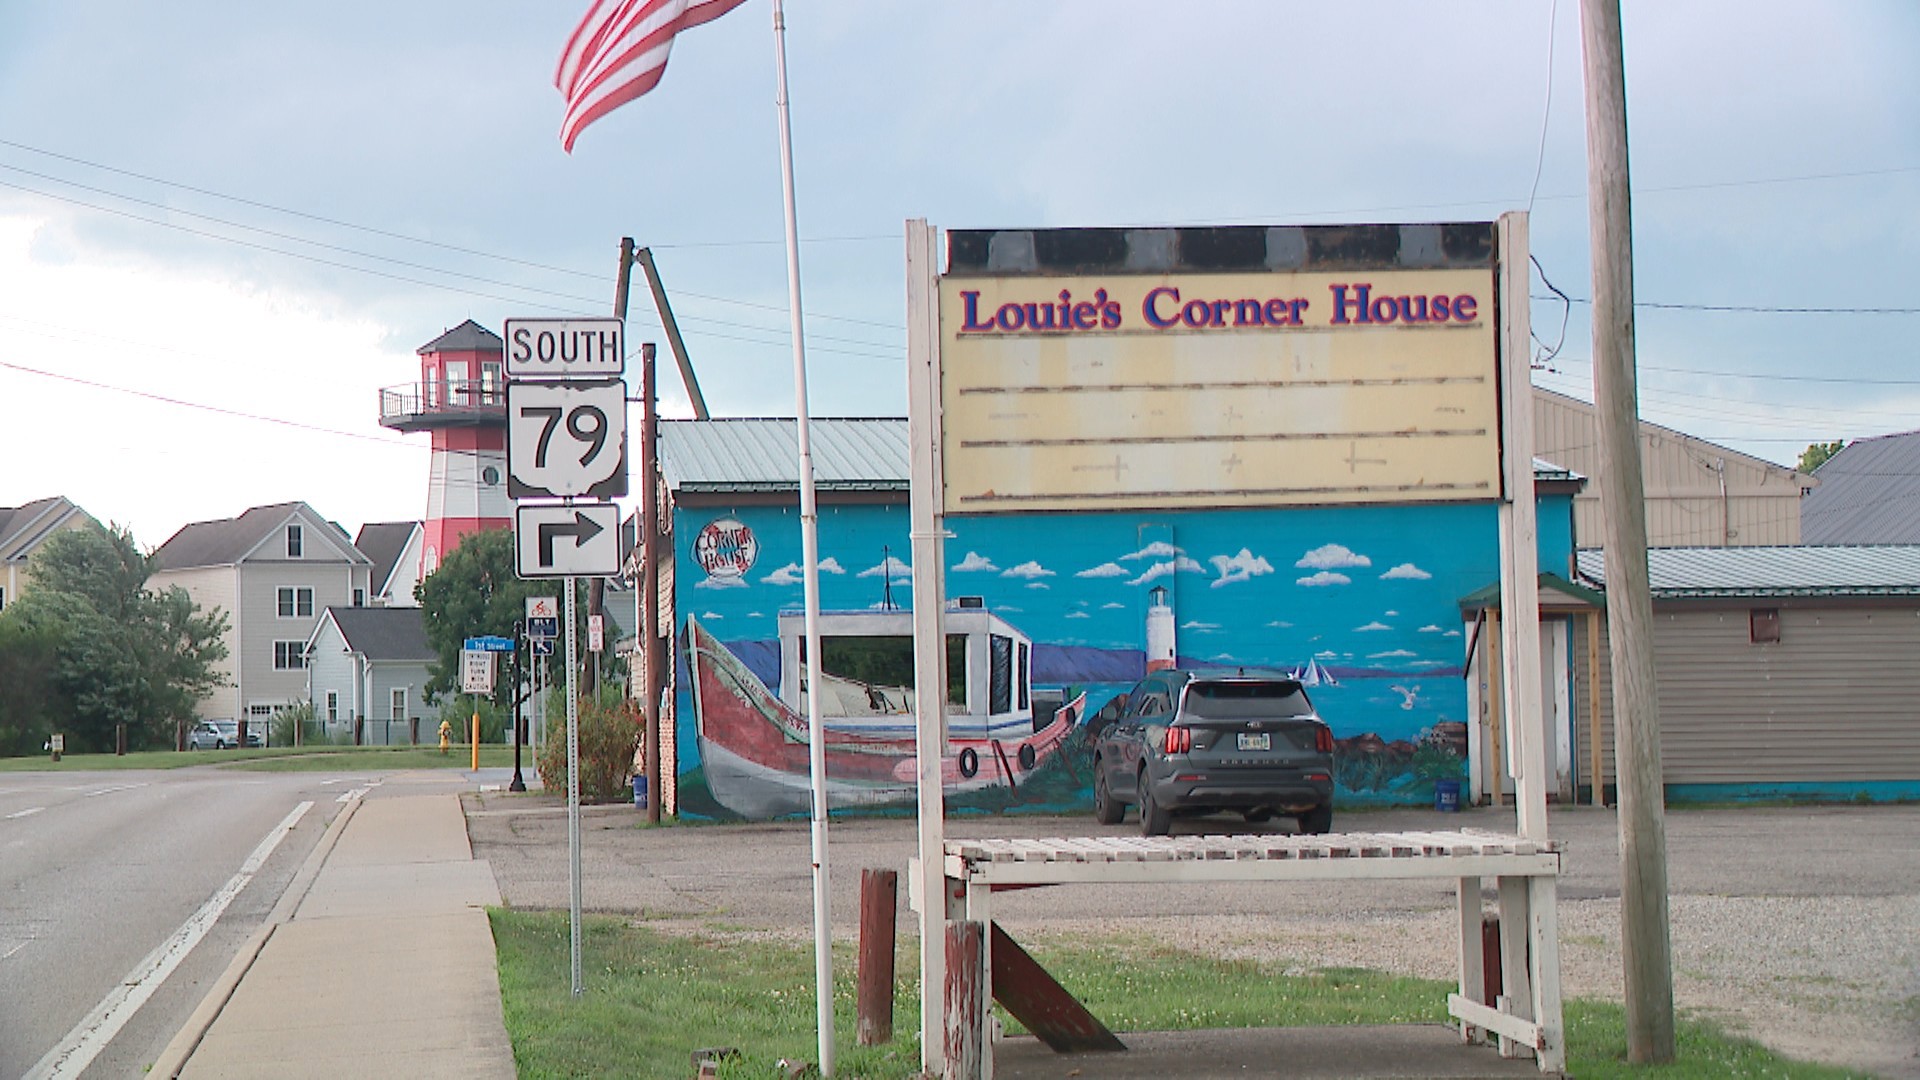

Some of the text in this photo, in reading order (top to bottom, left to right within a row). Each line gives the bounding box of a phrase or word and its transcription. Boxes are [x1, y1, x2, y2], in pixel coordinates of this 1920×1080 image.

[960, 282, 1478, 332] Louie's Corner House
[512, 328, 617, 363] SOUTH
[520, 405, 608, 468] 79
[696, 527, 752, 550] CORNER
[704, 547, 751, 572] HOUSE
